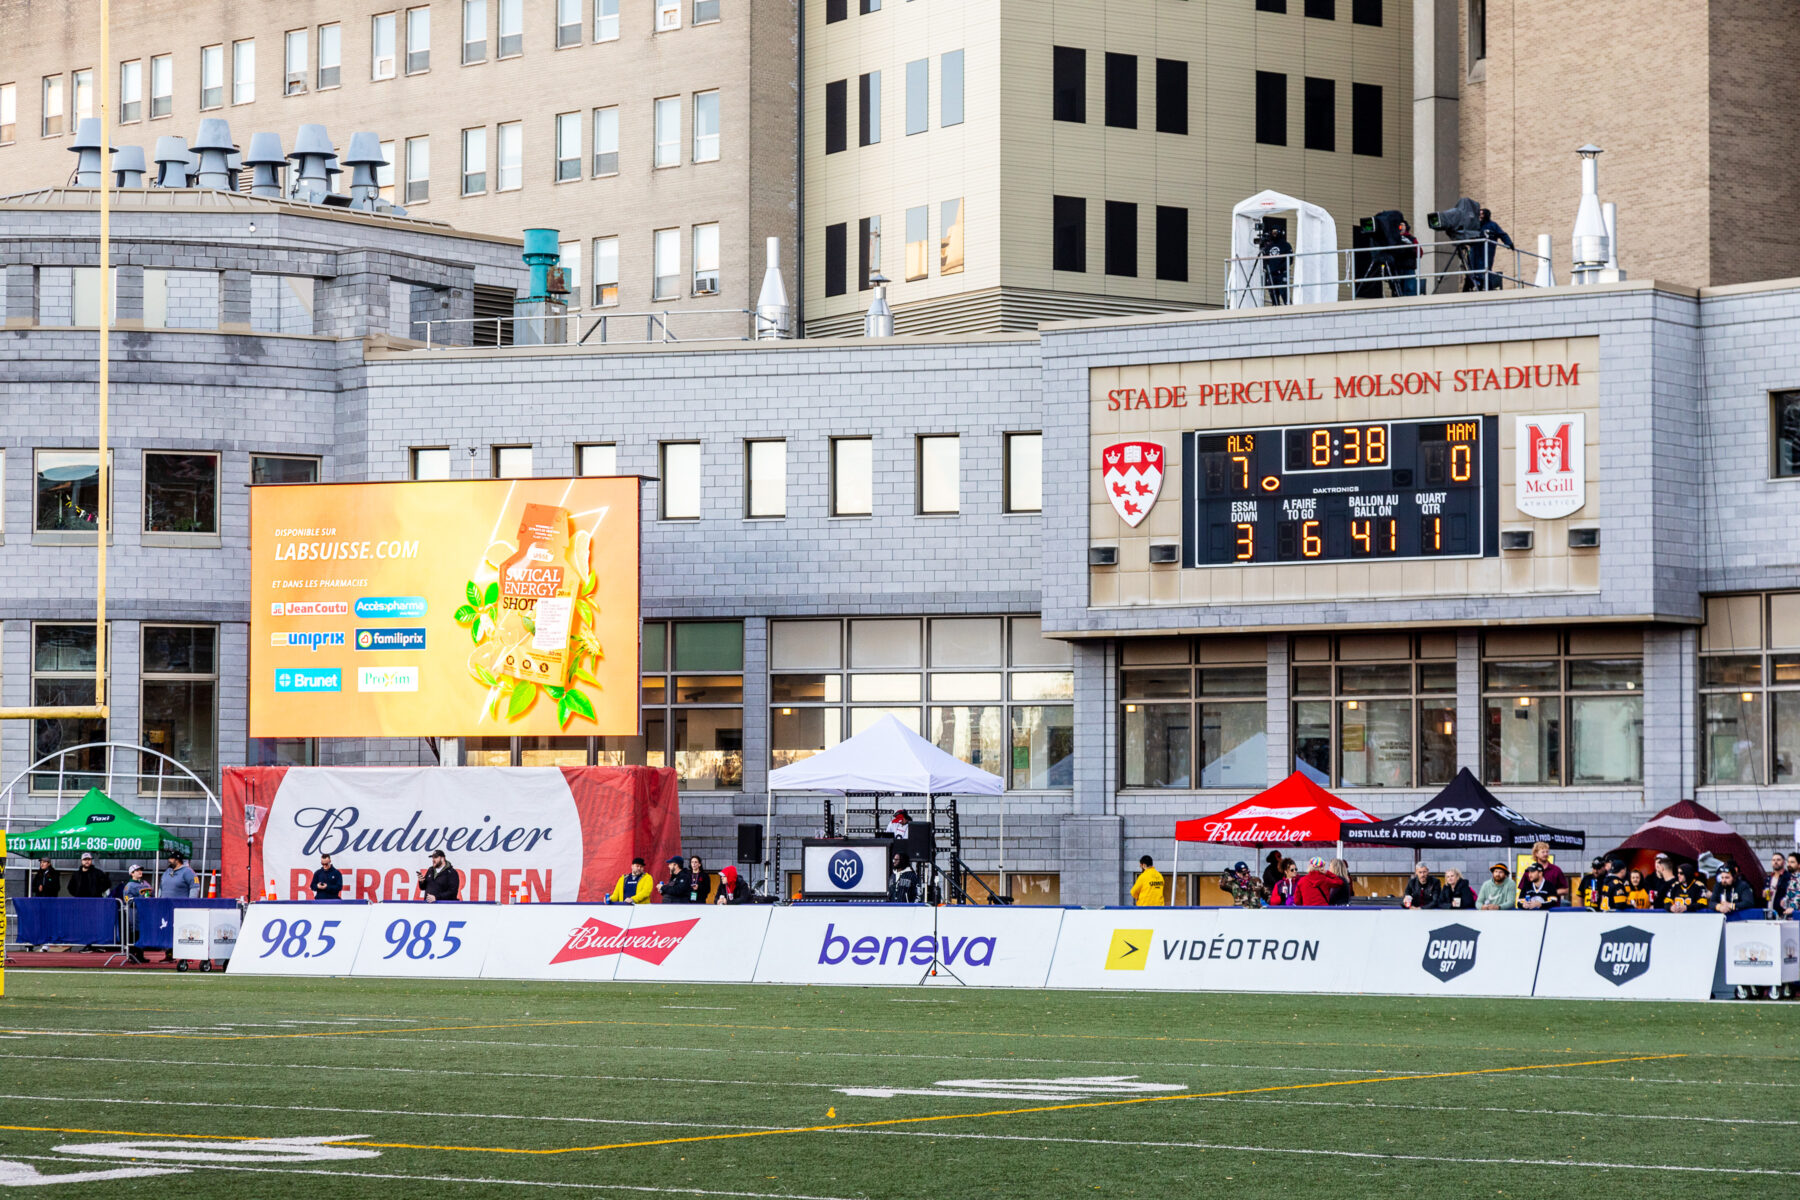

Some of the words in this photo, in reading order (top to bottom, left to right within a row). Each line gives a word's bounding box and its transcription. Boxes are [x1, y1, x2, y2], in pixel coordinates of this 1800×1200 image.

[1107, 385, 1188, 412] STADE
[1198, 378, 1323, 407] PERCIVAL
[1333, 370, 1442, 399] MOLSON
[1453, 362, 1581, 392] STADIUM
[1446, 422, 1476, 441] HAM
[1227, 434, 1254, 453] ALS
[1312, 426, 1385, 466] 8:38
[1451, 444, 1471, 481] 0
[1232, 456, 1249, 489] 7
[1312, 486, 1360, 494] DAKTRONICS
[1525, 478, 1574, 494] McGill
[1231, 501, 1257, 512] ESSAI
[1282, 499, 1290, 510] A
[1291, 498, 1317, 509] FAIRE
[1348, 496, 1384, 507] BALLON
[1385, 494, 1399, 505] AU
[1415, 492, 1447, 504] QUART
[1230, 511, 1258, 522] DOWN
[1287, 510, 1299, 520] TO
[1300, 508, 1315, 519] GO
[1354, 507, 1377, 517] BALL
[1378, 506, 1392, 516] ON
[1421, 504, 1441, 514] QTR
[275, 528, 320, 537] DISPONIBLE
[321, 527, 337, 536] SUR
[1236, 523, 1253, 559] 3
[1302, 520, 1321, 557] 6
[1351, 519, 1396, 553] 41
[1434, 517, 1441, 550] 1
[275, 540, 419, 561] LABSUISSE.COM
[272, 580, 281, 589] ET
[282, 579, 303, 588] DANS
[304, 579, 318, 587] LES
[319, 578, 369, 588] PHARMACIES
[505, 568, 560, 582] SWICAL
[504, 582, 559, 597] ENERGY
[287, 603, 314, 613] Jean
[315, 603, 347, 613] Coutu
[502, 597, 537, 611] SHOT
[288, 632, 345, 651] uniprix
[374, 631, 423, 646] familiprix
[294, 673, 338, 687] Brunet
[1399, 807, 1485, 824] NOROI
[294, 806, 552, 856] Budweiser
[1203, 822, 1312, 842] Budweiser
[1348, 828, 1391, 838] DISTILLÉE
[1392, 829, 1399, 838] À
[1400, 830, 1426, 839] FROID
[1435, 831, 1457, 840] COLD
[1458, 833, 1503, 843] DISTILLED
[8, 836, 26, 849] TÉO
[29, 838, 51, 850] TAXI
[61, 837, 142, 850] 514-836-0000
[259, 918, 341, 958] 98.5
[383, 918, 467, 960] 98.5
[568, 926, 684, 950] Budweiser
[818, 923, 997, 966] beneva
[1163, 933, 1320, 961] VIDÉOTRON
[1428, 940, 1475, 960] CHOM
[1600, 942, 1649, 963] CHOM
